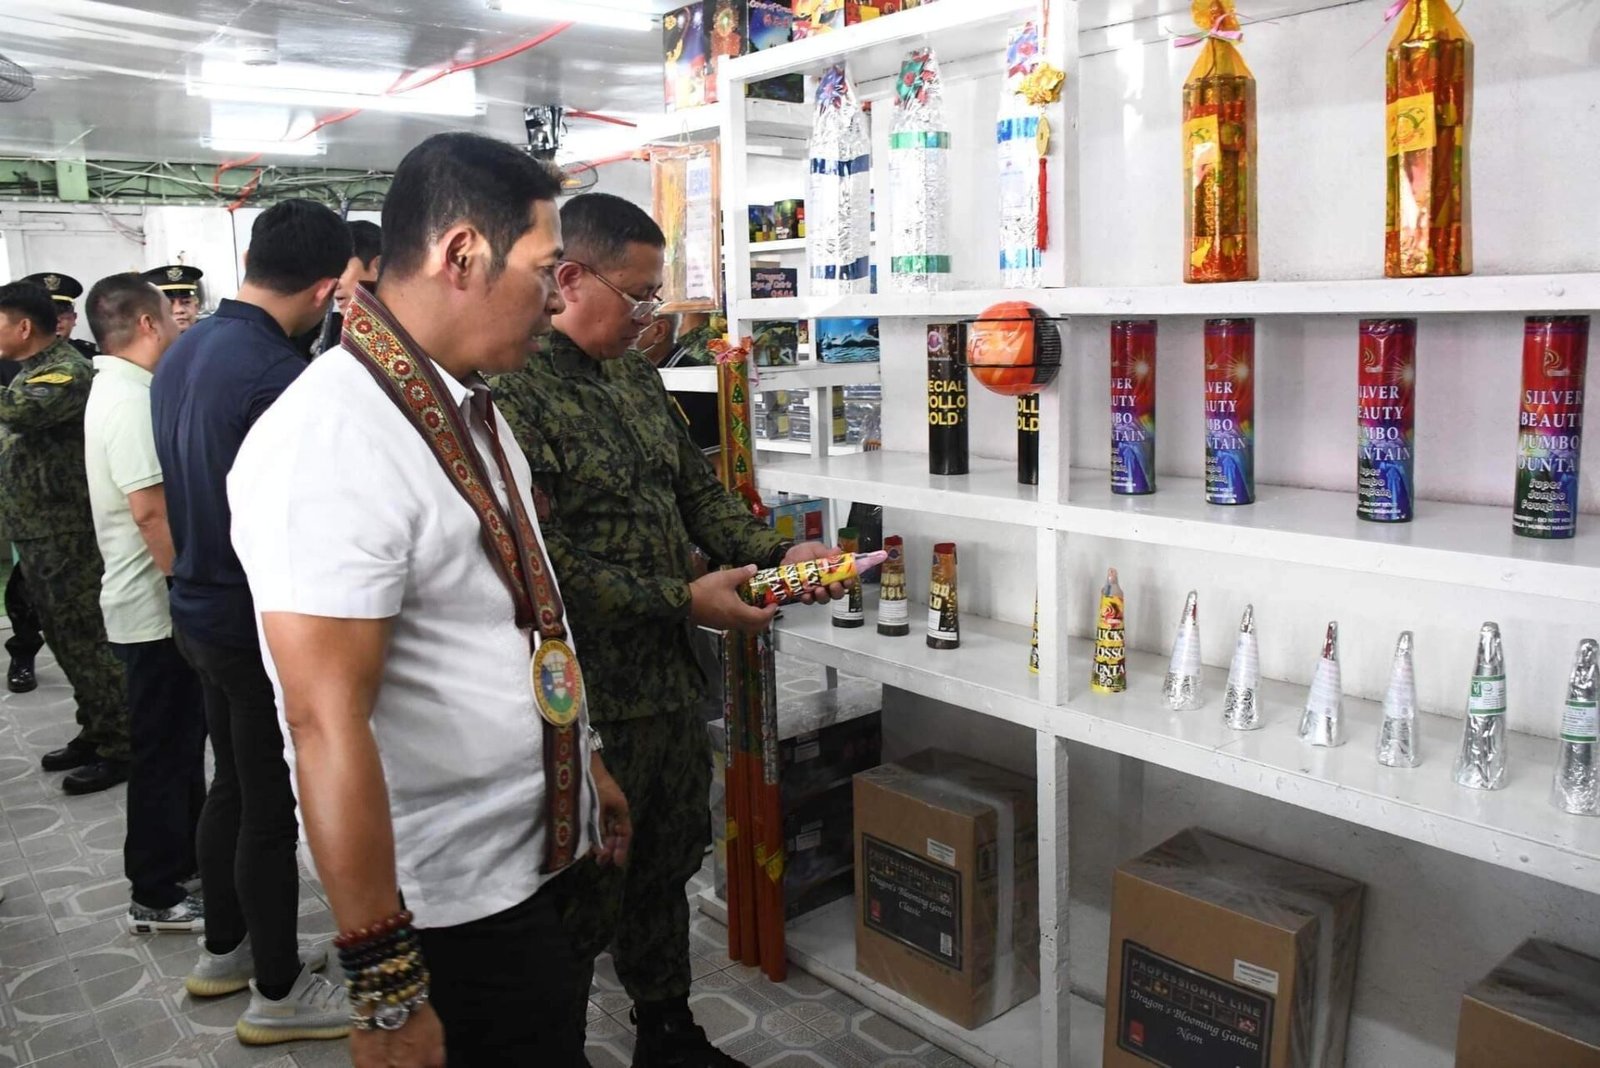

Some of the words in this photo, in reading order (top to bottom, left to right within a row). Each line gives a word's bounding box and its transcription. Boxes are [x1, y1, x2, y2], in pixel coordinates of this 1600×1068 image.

[928, 380, 965, 392] ECIAL
[928, 395, 966, 408] OLLO
[928, 412, 958, 425] OLD
[1112, 430, 1145, 441] TAIN
[1521, 434, 1580, 450] JUMBO
[1131, 958, 1225, 1003] PROFESSIONAL
[1230, 998, 1261, 1018] LINE
[1172, 1009, 1220, 1036] Blooming
[1221, 1030, 1259, 1050] Garden
